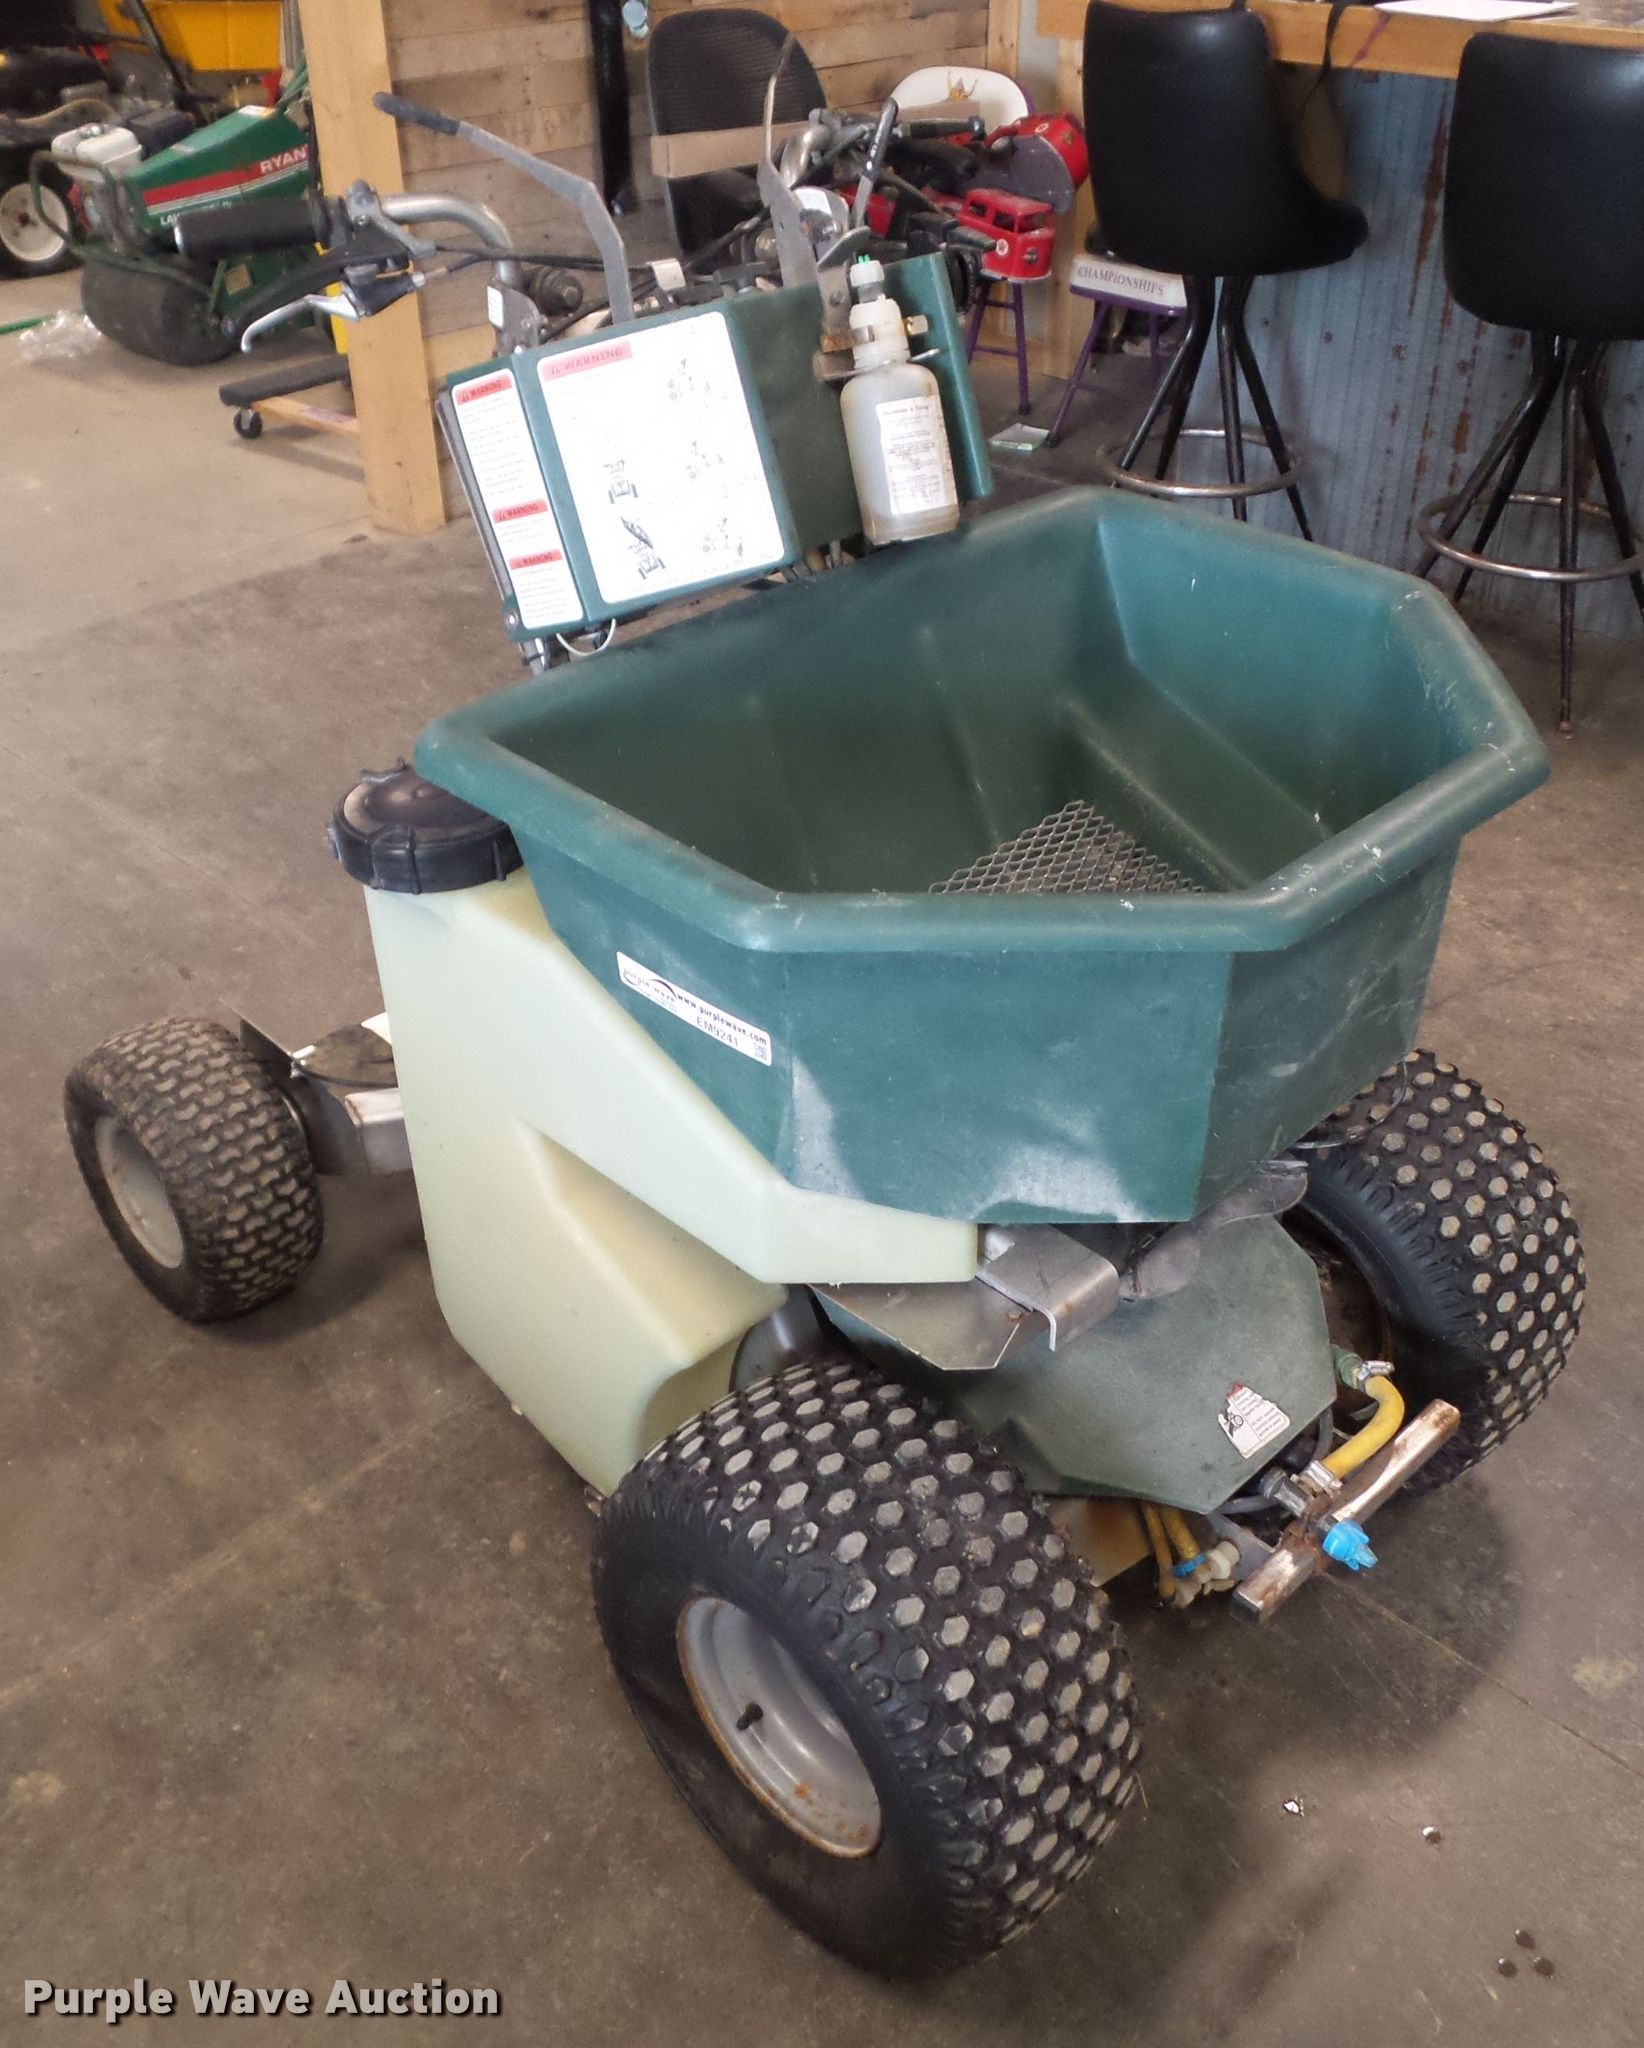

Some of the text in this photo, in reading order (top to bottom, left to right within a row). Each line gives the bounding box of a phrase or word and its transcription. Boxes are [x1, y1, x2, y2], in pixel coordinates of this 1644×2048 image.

[260, 143, 308, 173] RYAN
[1078, 266, 1164, 296] CHAMPIONSHIPS
[563, 347, 623, 370] WARNING
[471, 380, 503, 398] WARNING
[507, 503, 538, 516] WARNING
[523, 552, 553, 565] WARNING
[677, 993, 767, 1045] www.purplewave.com
[696, 1016, 738, 1047] EM9241
